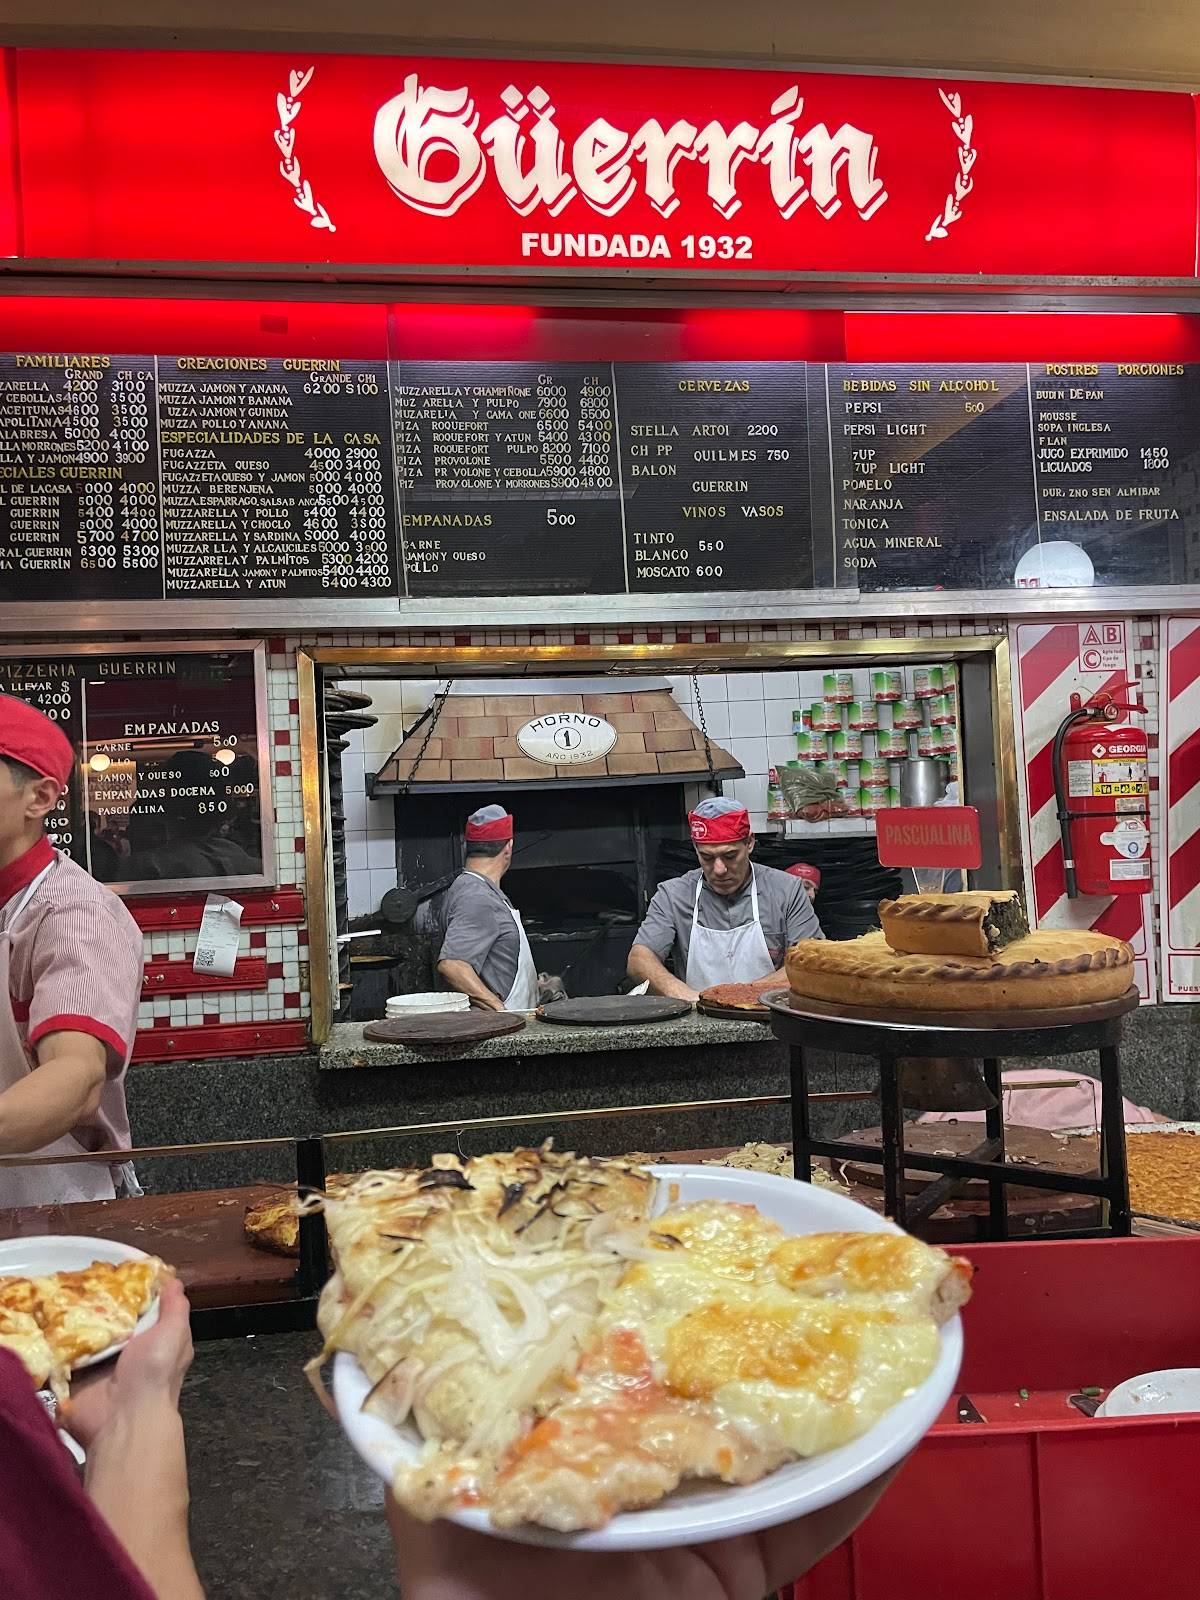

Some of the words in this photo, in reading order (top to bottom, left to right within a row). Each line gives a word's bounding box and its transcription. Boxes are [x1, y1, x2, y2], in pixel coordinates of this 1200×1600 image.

[522, 233, 671, 258] FUNDADA
[681, 235, 753, 259] 1932
[16, 355, 111, 368] FAMILIARES
[177, 358, 267, 370] CREACIONES
[283, 360, 340, 372] GUERRIN
[118, 371, 132, 379] CH
[1046, 364, 1098, 375] POSTRES
[1118, 365, 1184, 375] PORCIONES
[159, 384, 196, 393] MUZZA
[200, 384, 236, 393] JAMON
[239, 385, 247, 393] Y
[250, 385, 288, 394] ANANA
[303, 383, 340, 394] 6200
[679, 381, 750, 392] CERVEZAS
[843, 381, 896, 391] BEBIDAS
[909, 381, 930, 391] SIN
[939, 381, 999, 392] ALCOHOL
[6, 394, 63, 403] CEBOLLAS
[63, 392, 97, 404] 4600
[111, 393, 145, 404] 3500
[1036, 390, 1064, 400] BUDIN
[1070, 389, 1083, 399] DE
[1086, 390, 1104, 399] PAN
[159, 396, 196, 405] MUZZA
[199, 396, 236, 405] JAMON
[238, 396, 246, 405] Y
[248, 396, 293, 406] BANANA
[845, 403, 882, 413] PEPSI
[1040, 413, 1077, 421] MOUSSE
[432, 422, 488, 430] ROQUEFORT
[536, 421, 568, 430] 6500
[578, 421, 612, 430] 5400
[631, 425, 679, 436] STELLA
[748, 425, 778, 436] 2200
[844, 425, 875, 435] PEPSI
[887, 424, 927, 435] LIGHT
[1038, 423, 1062, 432] SOPA
[161, 432, 280, 444] ESPECIALIDADES
[286, 433, 304, 444] DE
[314, 433, 333, 444] LA
[344, 434, 381, 445] CASA
[433, 433, 489, 442] ROQUEFORT
[505, 434, 531, 442] ATUN
[538, 432, 568, 442] 5400
[578, 432, 611, 442] 4300
[1039, 437, 1067, 445] FLAN
[28, 454, 35, 463] Y
[38, 454, 75, 463] JAMON
[75, 452, 108, 463] 4900
[115, 452, 145, 463] 3900
[162, 449, 215, 459] FUGAZZA
[304, 448, 340, 459] 4000
[346, 448, 377, 459] 2900
[694, 450, 756, 461] QUILMES
[767, 450, 789, 461] 750
[853, 450, 875, 460] 7UP
[1037, 448, 1064, 458] JUGO
[1070, 448, 1128, 458] EXPRIMIDO
[434, 457, 491, 465] PROVOLONE
[578, 455, 608, 465] 4400
[632, 465, 676, 476] BALON
[855, 463, 877, 474] 7UP
[889, 463, 925, 474] LIGHT
[1040, 462, 1092, 472] LICUADOS
[60, 467, 122, 479] GUERRIN
[163, 485, 200, 494] MUZZA
[209, 485, 273, 494] BERENJENA
[309, 484, 341, 494] 5000
[348, 484, 381, 494] 4000
[693, 481, 748, 492] GUERRIN
[843, 480, 892, 490] POMELO
[843, 499, 903, 509] NARANJA
[10, 508, 60, 518] GUERRIN
[78, 507, 114, 518] 5400
[121, 507, 155, 518] 4400
[164, 509, 238, 518] MUZZARELLA
[242, 509, 249, 518] Y
[256, 509, 288, 518] POLLO
[304, 507, 336, 517] 5400
[349, 507, 385, 517] 4400
[402, 515, 492, 526] EMPANADAS
[547, 508, 576, 525] 500
[682, 507, 726, 517] VINOS
[741, 506, 784, 517] VASOS
[1044, 510, 1109, 521] ENSALADA
[1116, 510, 1132, 520] DE
[1139, 509, 1179, 520] FRUTA
[842, 519, 889, 529] TONICA
[10, 533, 60, 542] GUERRIN
[77, 531, 114, 544] 5700
[121, 530, 159, 542] 4700
[843, 538, 876, 548] AGUA
[885, 537, 942, 548] MINERAL
[25, 548, 72, 557] GUERRIN
[81, 545, 116, 556] 6300
[123, 546, 159, 556] 5300
[453, 552, 486, 561] QUESO
[635, 550, 688, 561] BLANCO
[844, 558, 877, 568] SODA
[636, 566, 690, 578] MOSCATO
[696, 566, 723, 577] 600
[167, 580, 240, 590] MUZZARELLA
[246, 580, 253, 588] Y
[259, 579, 286, 589] ATUN
[322, 577, 357, 588] 5400
[361, 577, 391, 588] 4300
[1086, 630, 1098, 642] A
[1107, 627, 1117, 642] B
[1086, 652, 1097, 666] C
[100, 661, 176, 676] GUERRIN
[61, 681, 69, 692] $
[38, 693, 71, 705] 4200
[124, 721, 219, 736] EMPANADAS
[530, 715, 600, 732] HORNO
[564, 731, 570, 746] 1
[96, 743, 131, 752] CARNE
[570, 750, 593, 759] 1932
[97, 773, 132, 782] JAMON
[148, 771, 181, 780] QUESO
[95, 788, 165, 800] EMPANADAS
[170, 787, 215, 797] DOCENA
[226, 783, 253, 795] 5000
[98, 805, 164, 815] PASCUALINA
[199, 801, 227, 814] 850
[886, 824, 973, 846] PASCUALINA
